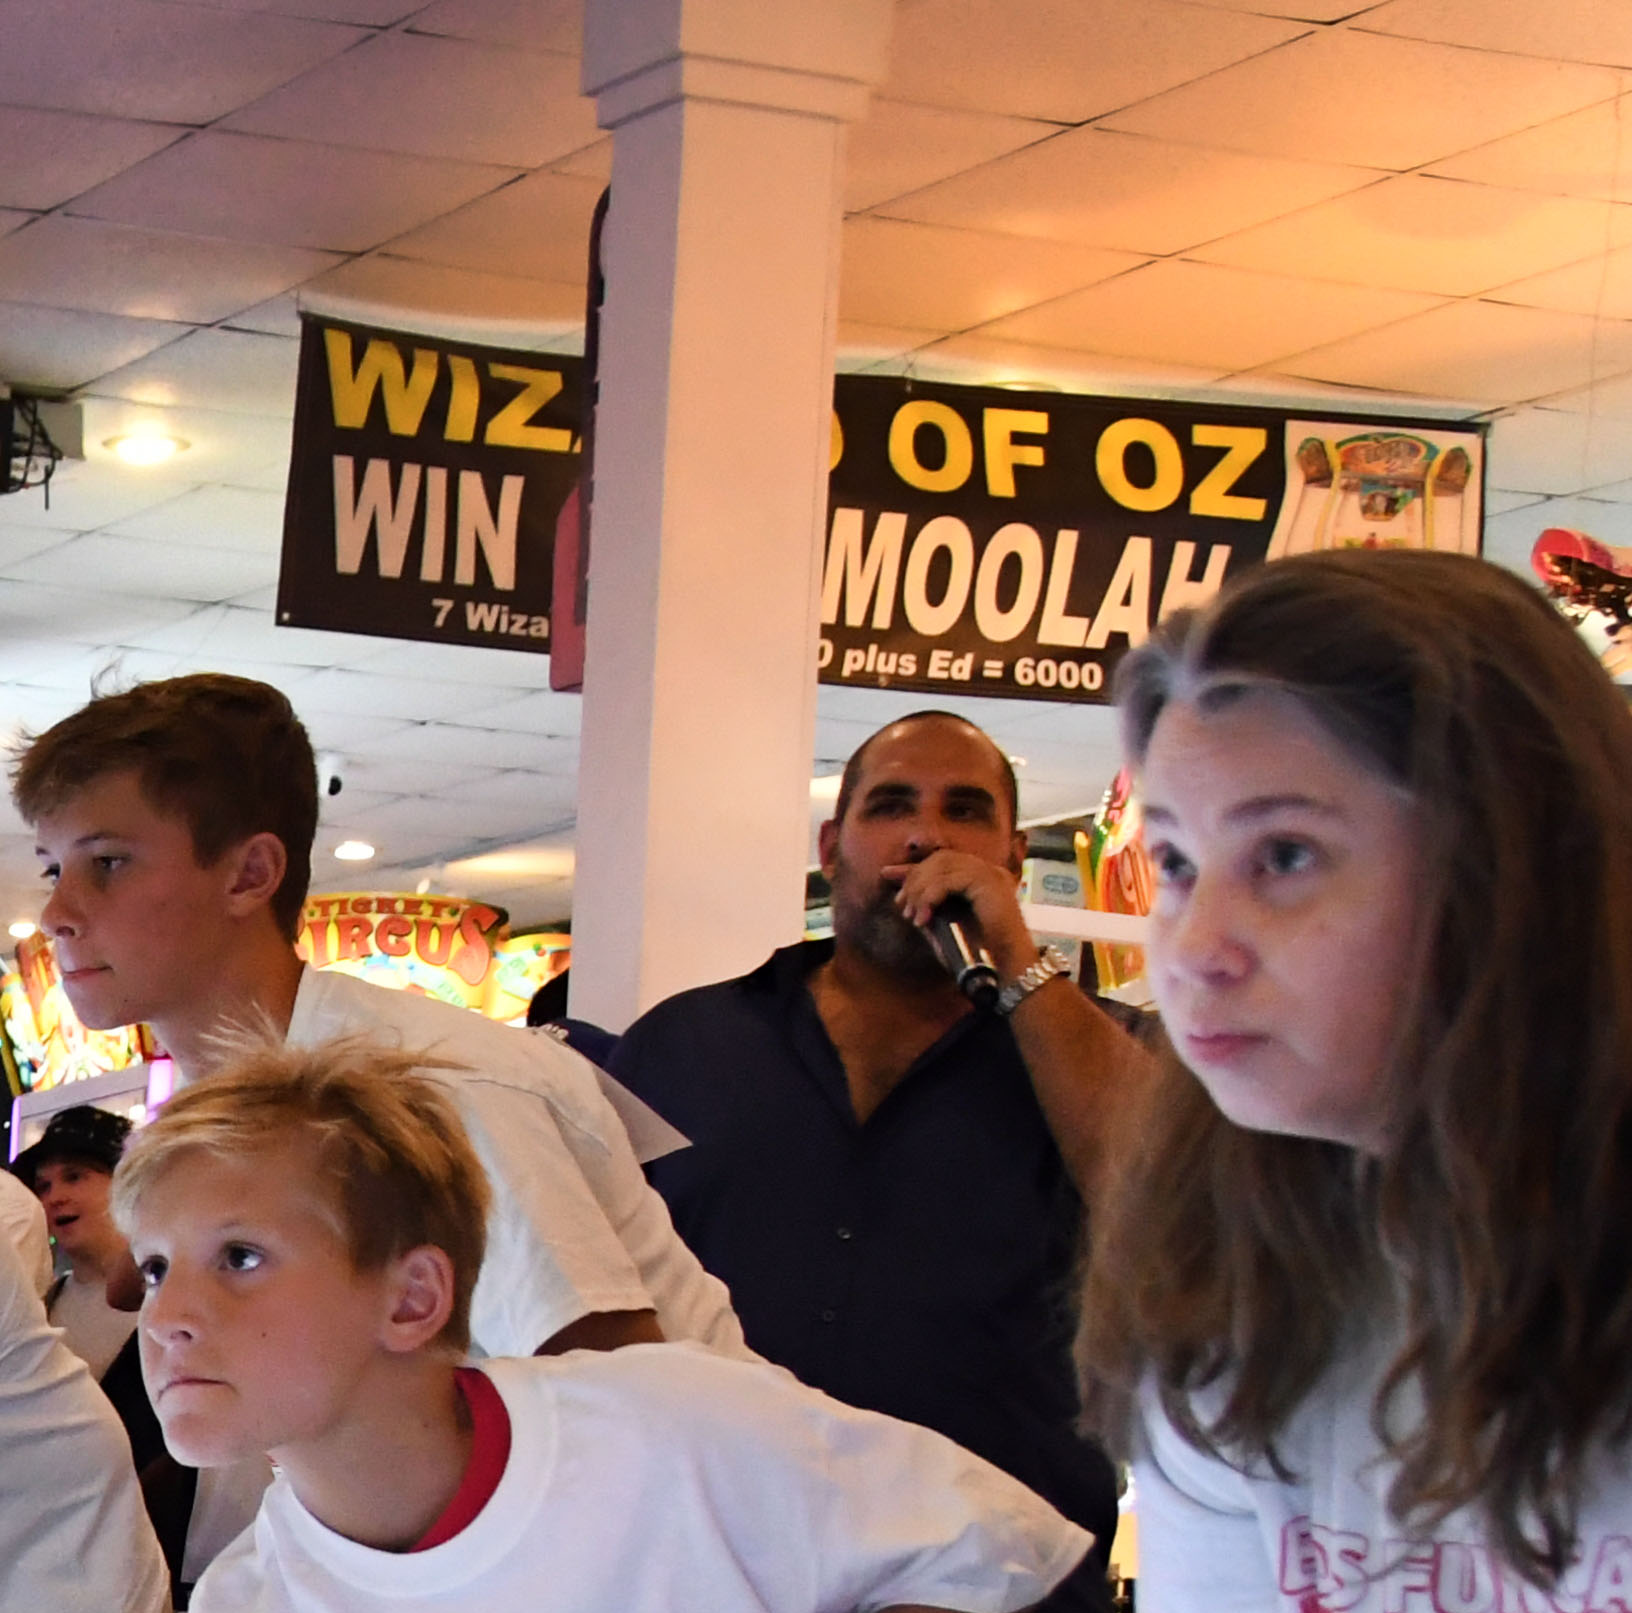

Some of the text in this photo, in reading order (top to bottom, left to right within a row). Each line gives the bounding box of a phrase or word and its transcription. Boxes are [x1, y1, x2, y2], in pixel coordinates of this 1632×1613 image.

[324, 328, 582, 453] WIZ
[888, 400, 1050, 498] OF
[1095, 416, 1268, 522] OZ
[333, 454, 524, 591] WIN
[431, 598, 551, 638] 7 Wiza
[841, 642, 917, 678] plus
[928, 649, 973, 682] Ed
[1014, 657, 1103, 691] 6000
[298, 904, 499, 987] IRCUS
[313, 896, 446, 918] TICKET
